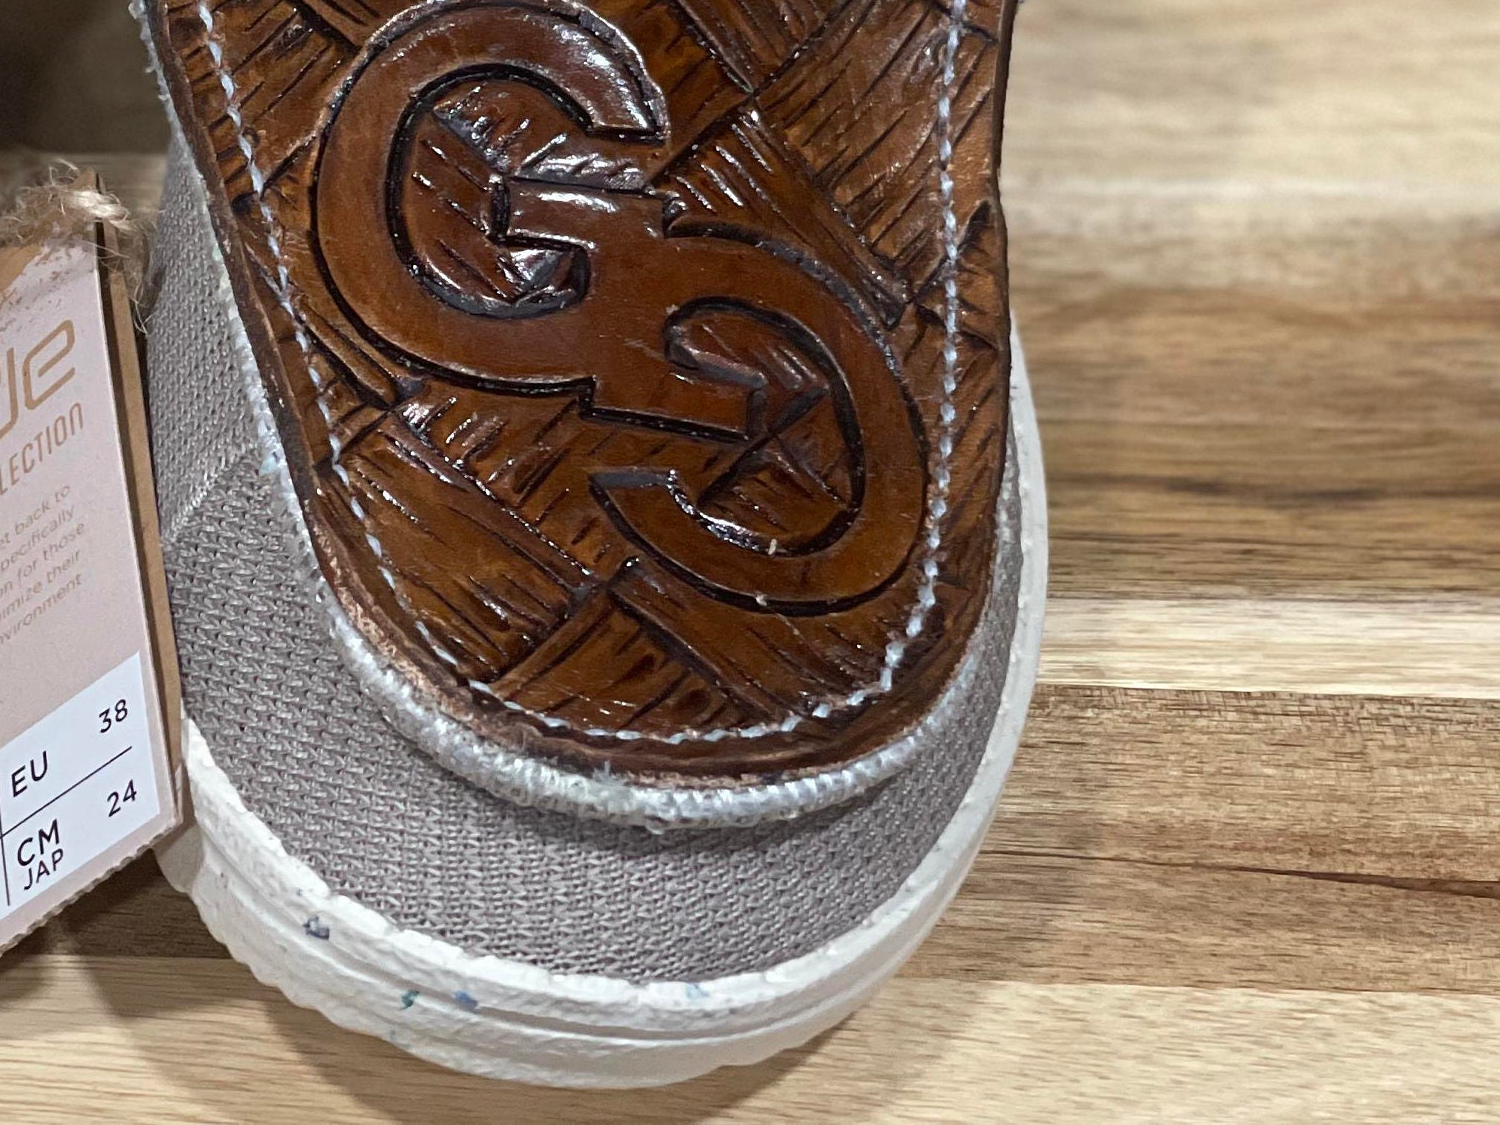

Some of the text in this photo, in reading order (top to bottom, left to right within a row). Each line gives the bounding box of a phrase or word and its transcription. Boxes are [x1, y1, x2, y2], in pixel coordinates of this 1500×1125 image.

[15, 499, 50, 535] back
[54, 484, 71, 504] to
[17, 558, 38, 582] for
[43, 521, 86, 562] those
[47, 549, 82, 583] their
[11, 698, 129, 798] EU 38
[16, 779, 138, 868] CM 24
[23, 848, 64, 891] JAP
